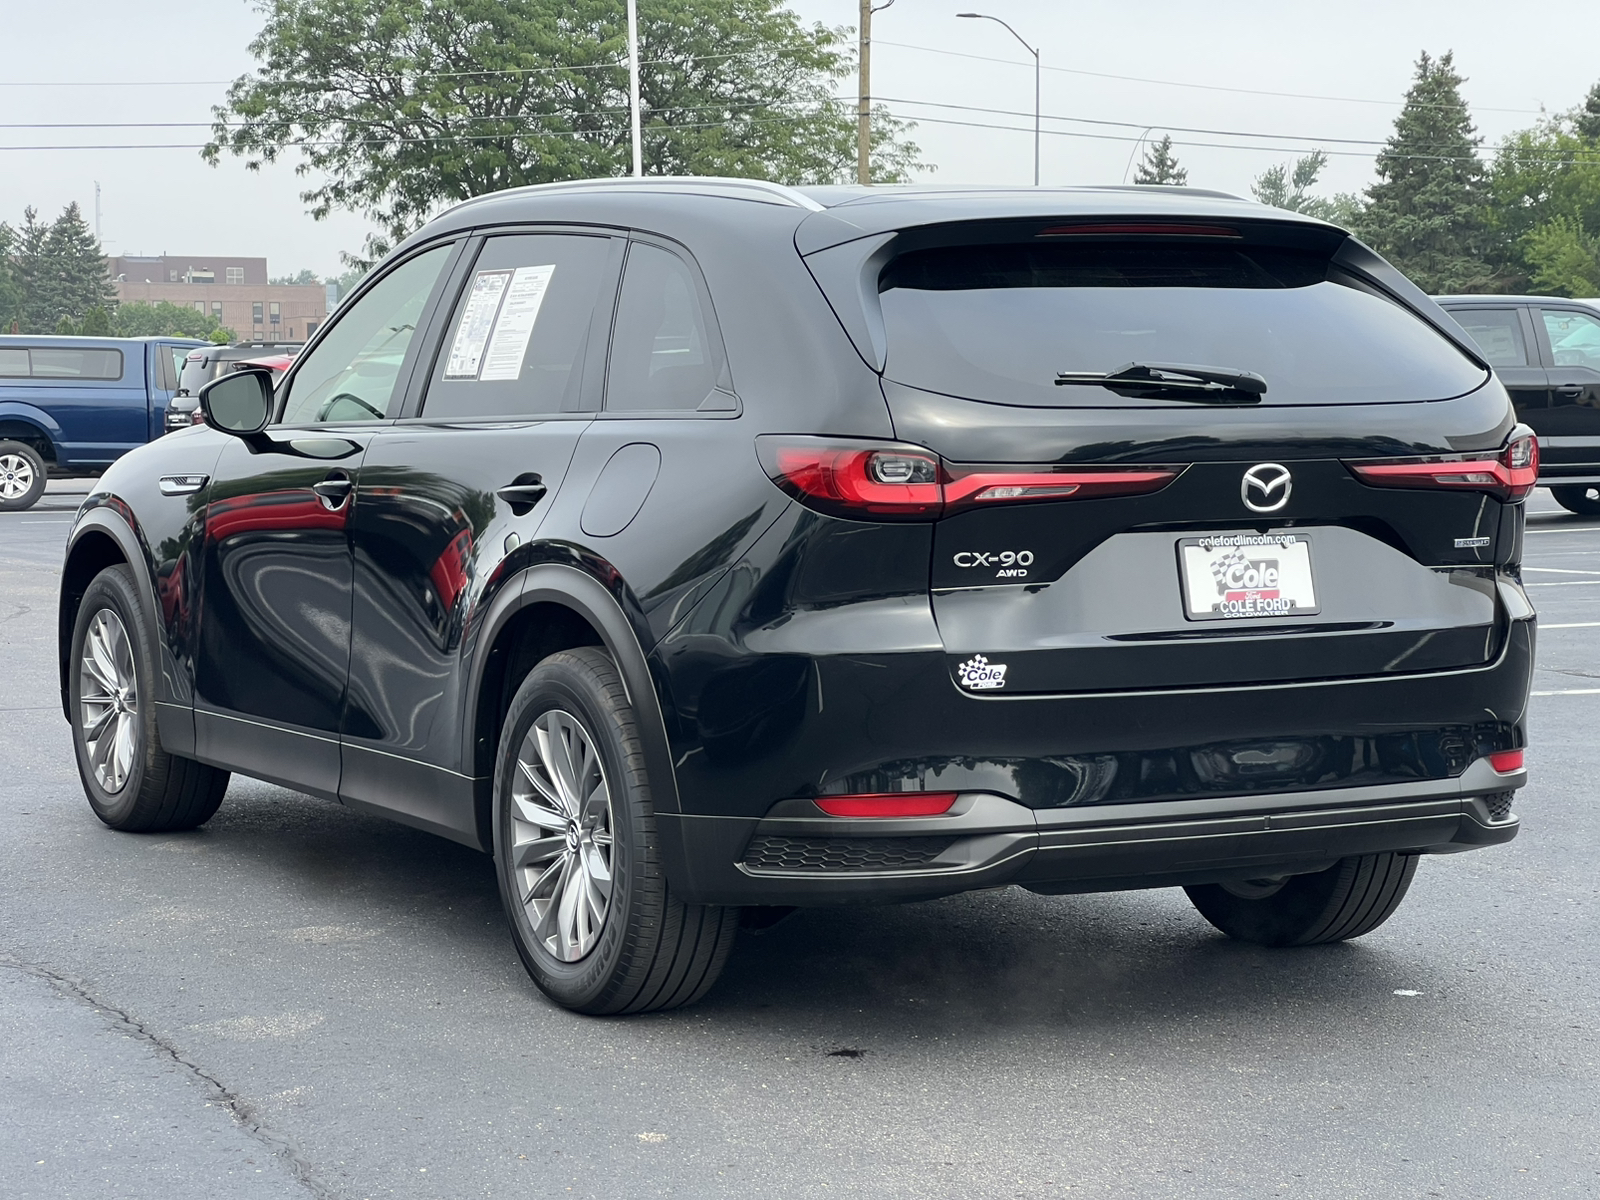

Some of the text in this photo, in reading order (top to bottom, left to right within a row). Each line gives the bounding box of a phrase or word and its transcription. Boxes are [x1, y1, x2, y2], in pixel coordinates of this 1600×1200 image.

[1199, 534, 1296, 546] colefordlincoln.com
[953, 550, 1034, 567] CX-90
[996, 569, 1028, 577] AWD
[1225, 562, 1279, 589] Cole
[1220, 598, 1290, 613] COLE FORD
[1224, 610, 1289, 618] COLDWATER
[966, 669, 1002, 681] Cole
